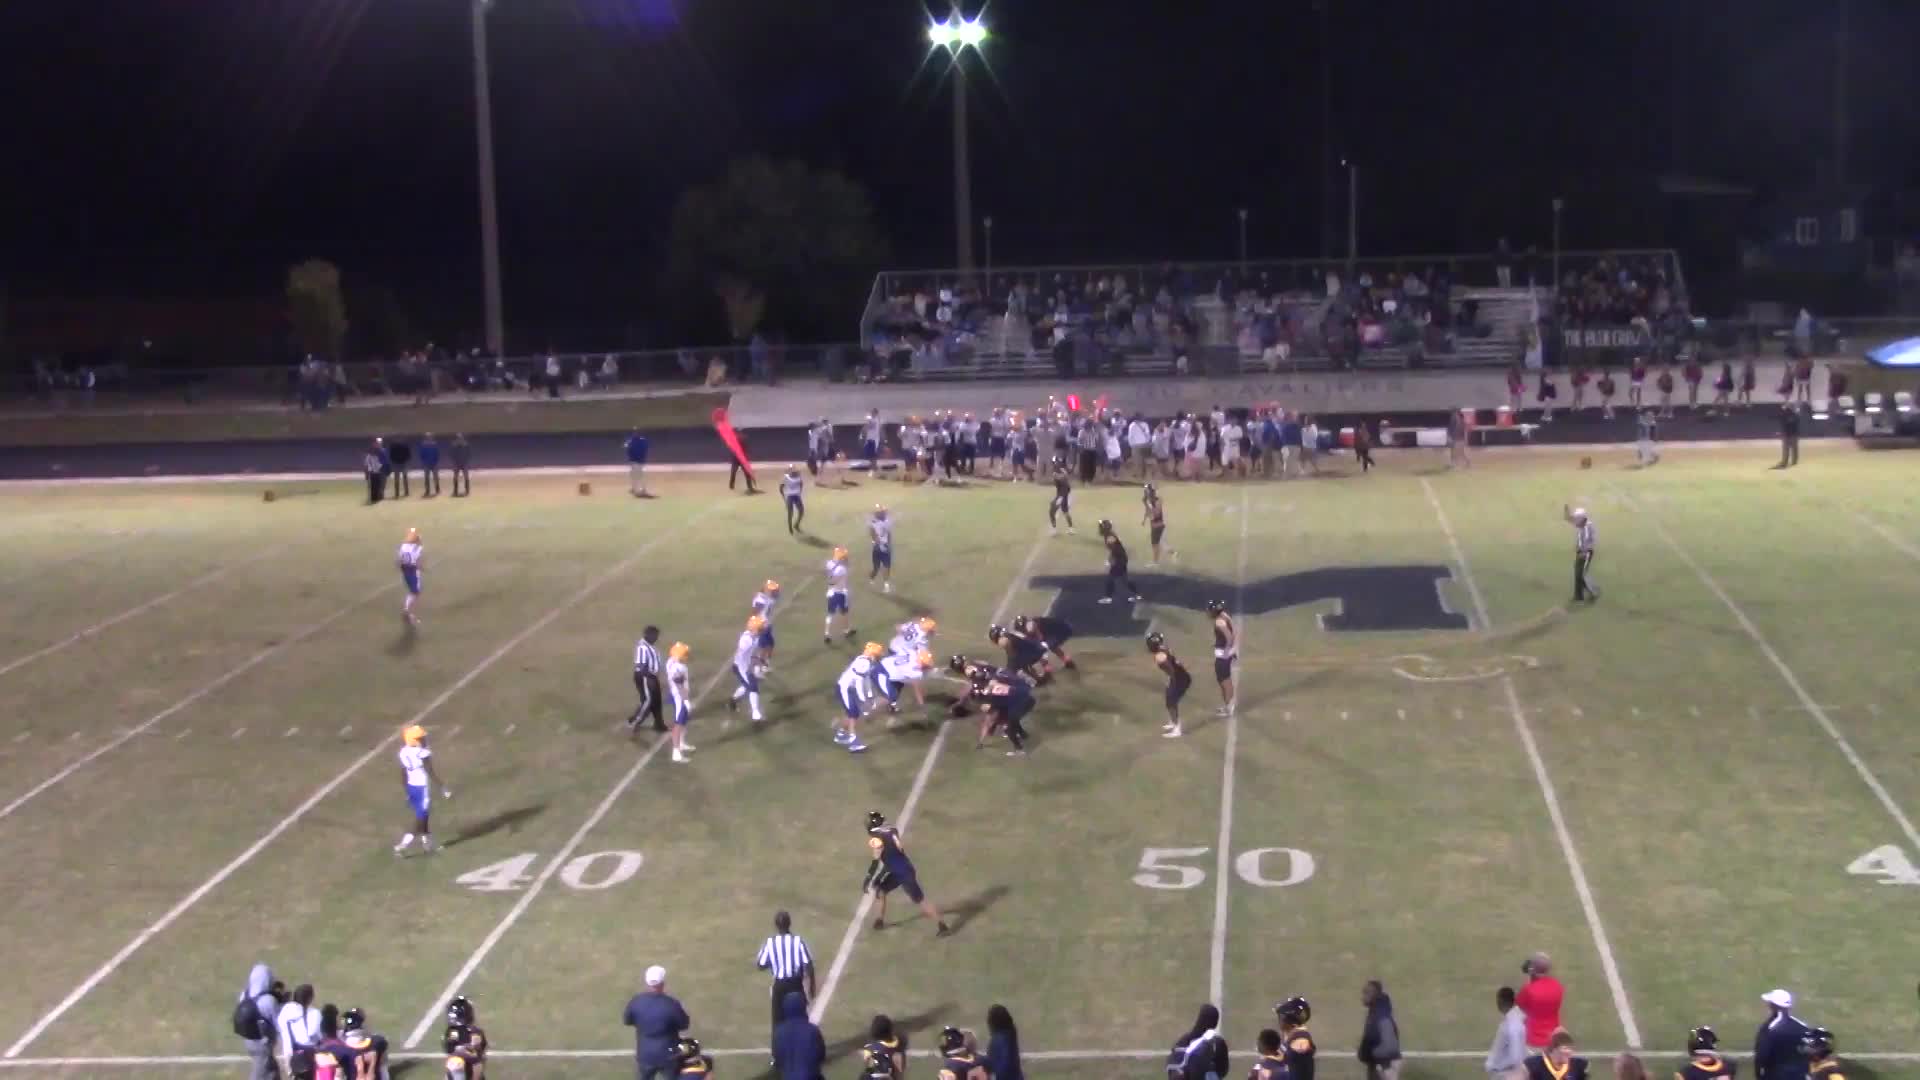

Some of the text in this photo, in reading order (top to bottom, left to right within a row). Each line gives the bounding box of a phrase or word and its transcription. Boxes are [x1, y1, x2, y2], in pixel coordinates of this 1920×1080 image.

[1029, 564, 1474, 638] M
[455, 850, 644, 891] 40
[1132, 847, 1315, 888] 50
